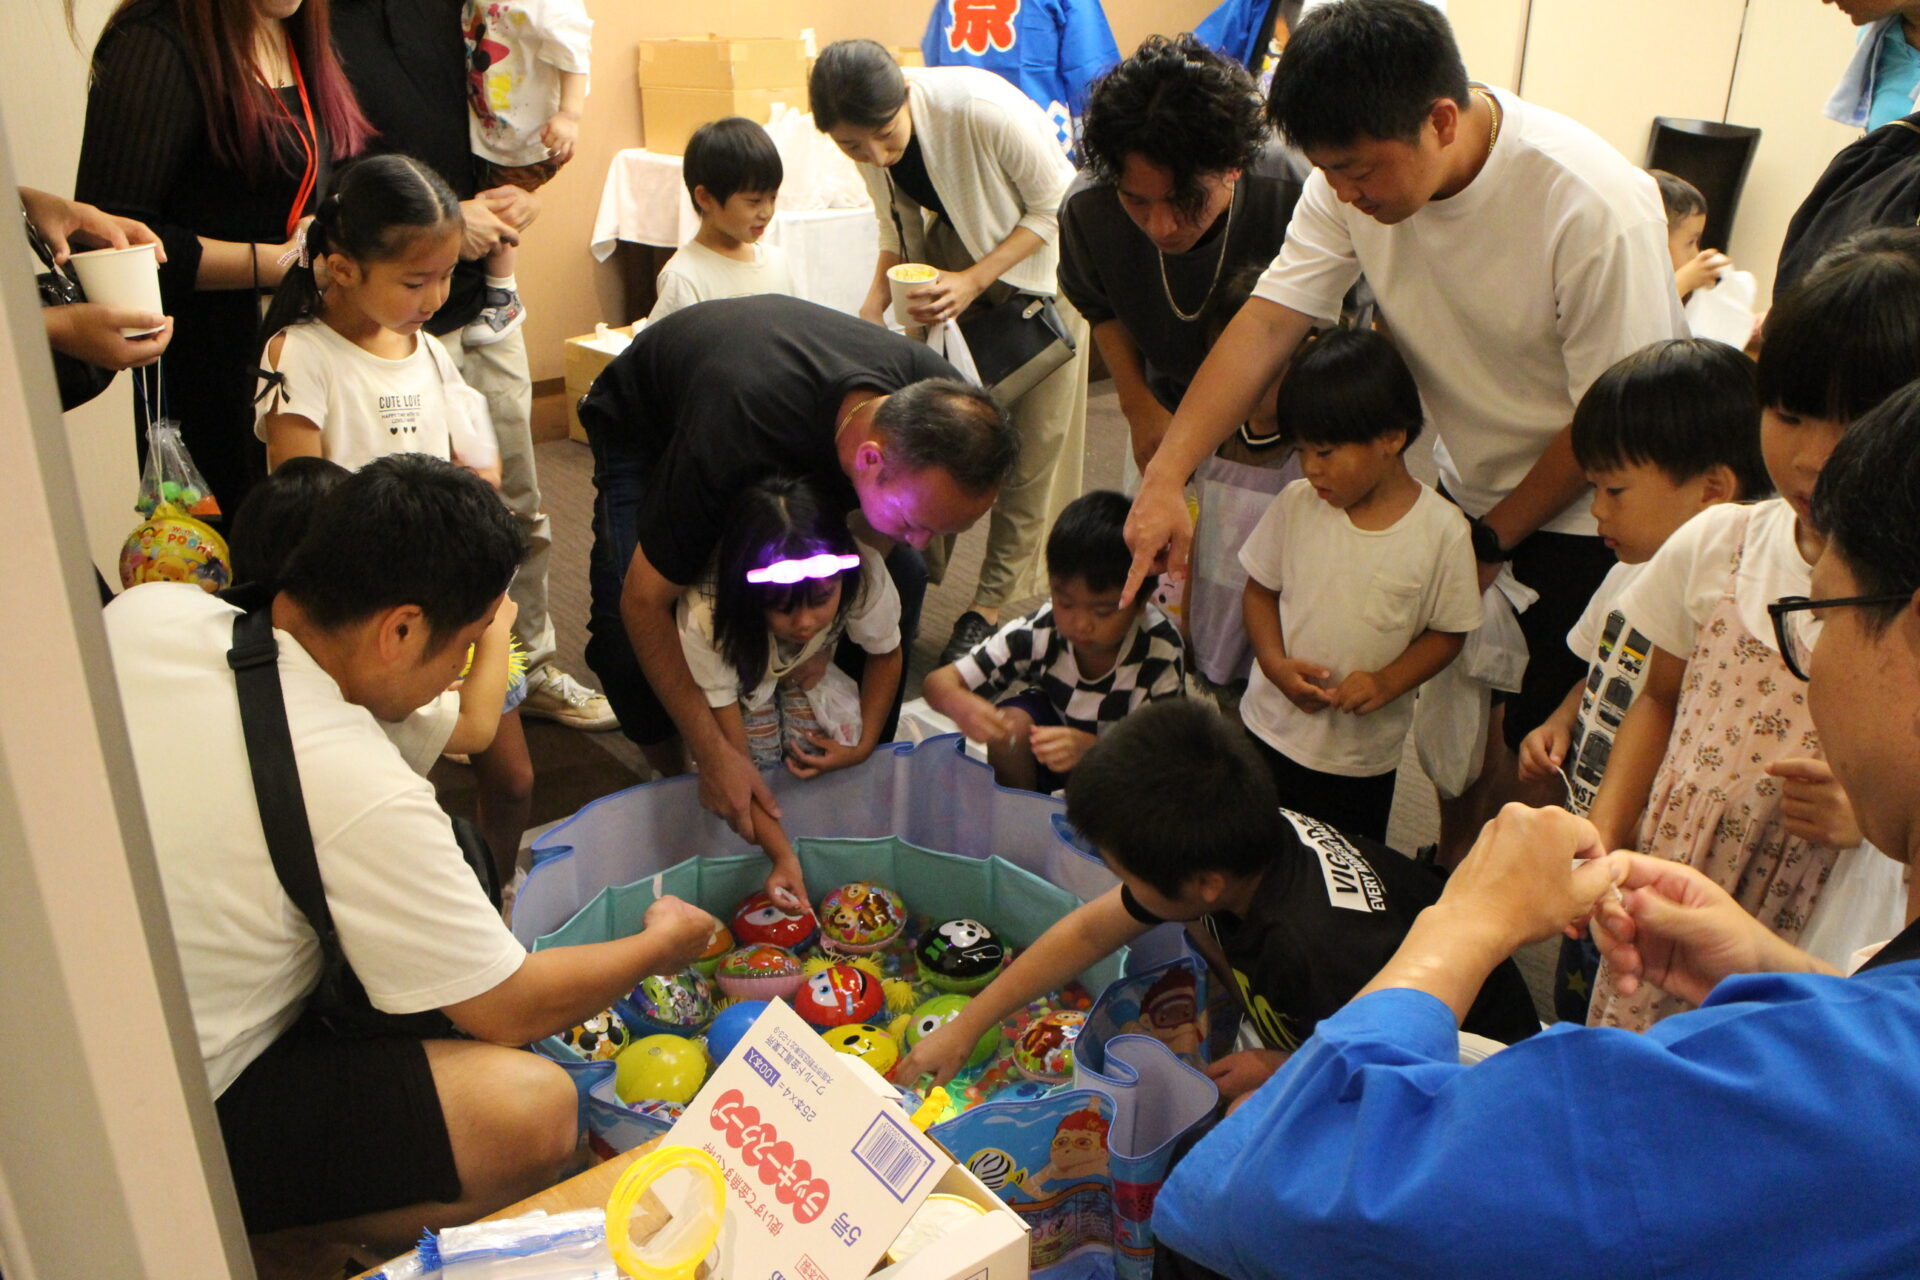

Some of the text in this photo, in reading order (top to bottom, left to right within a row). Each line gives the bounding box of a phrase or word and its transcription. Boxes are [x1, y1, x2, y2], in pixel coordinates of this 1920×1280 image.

[379, 394, 421, 409] CUTE LOVE
[1360, 872, 1386, 911] EVERY
[744, 1048, 779, 1084] 100本入
[764, 1034, 825, 1096] ワールド金属工業所
[711, 1105, 824, 1216] ラッキースクープ
[829, 1211, 863, 1248] 5号
